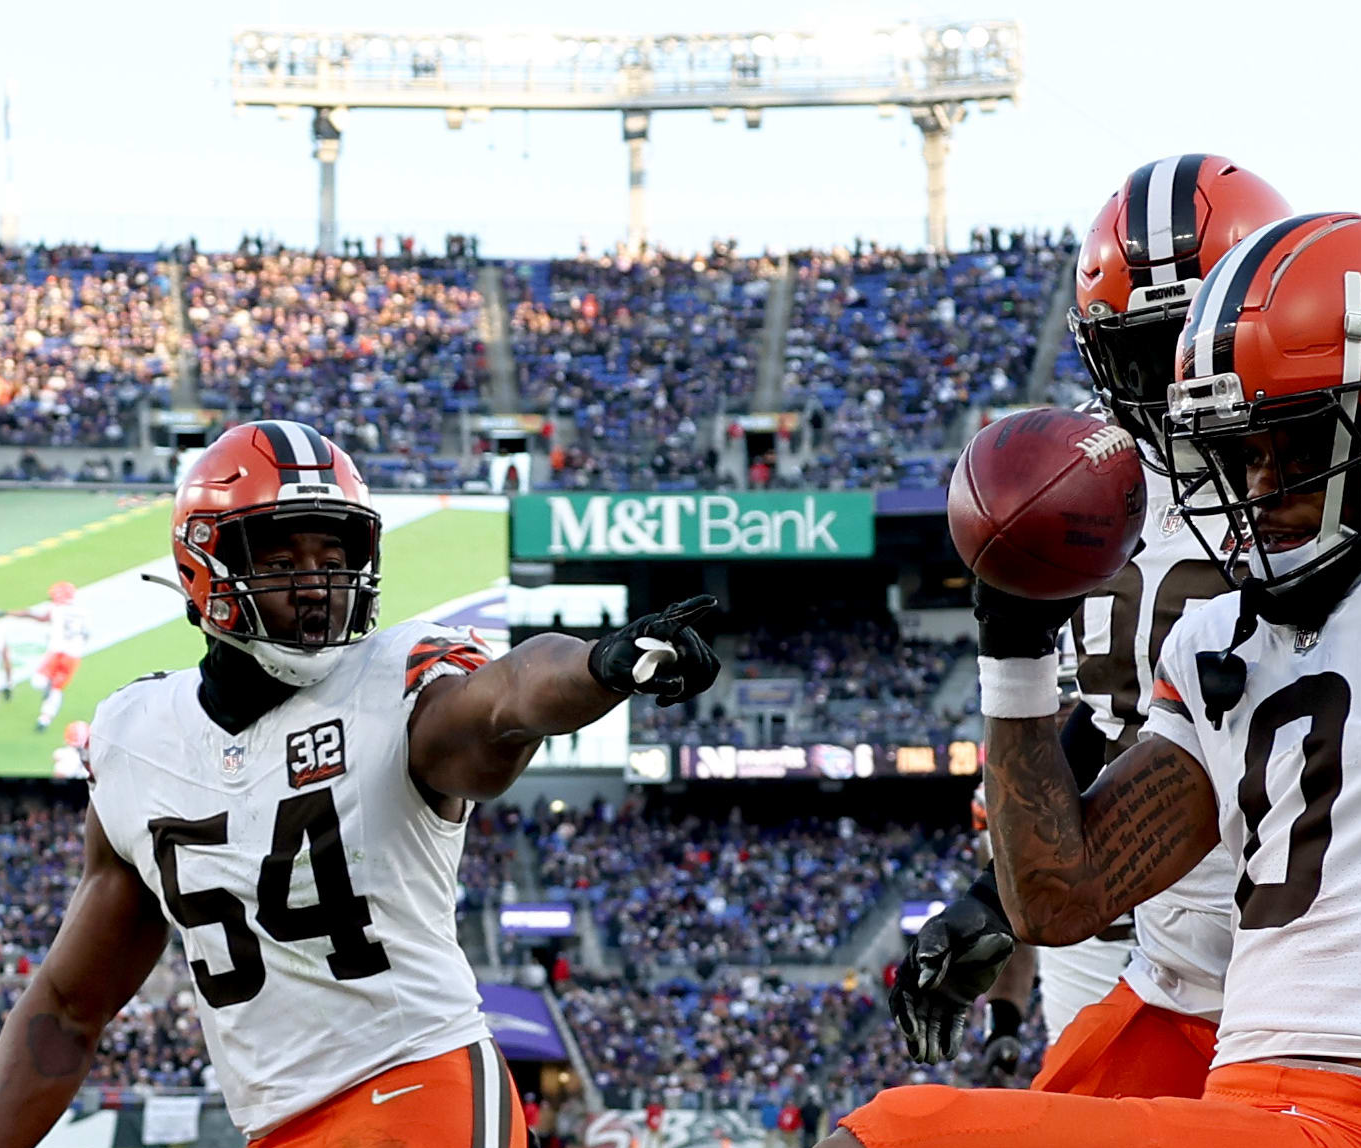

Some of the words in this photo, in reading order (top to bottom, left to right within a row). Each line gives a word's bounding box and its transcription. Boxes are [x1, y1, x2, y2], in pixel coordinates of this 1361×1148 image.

[1144, 284, 1186, 302] BROWNS
[547, 496, 696, 554] M&T
[700, 495, 838, 553] Bank
[291, 725, 341, 774] 32
[1235, 671, 1351, 929] 0
[148, 786, 391, 1006] 54
